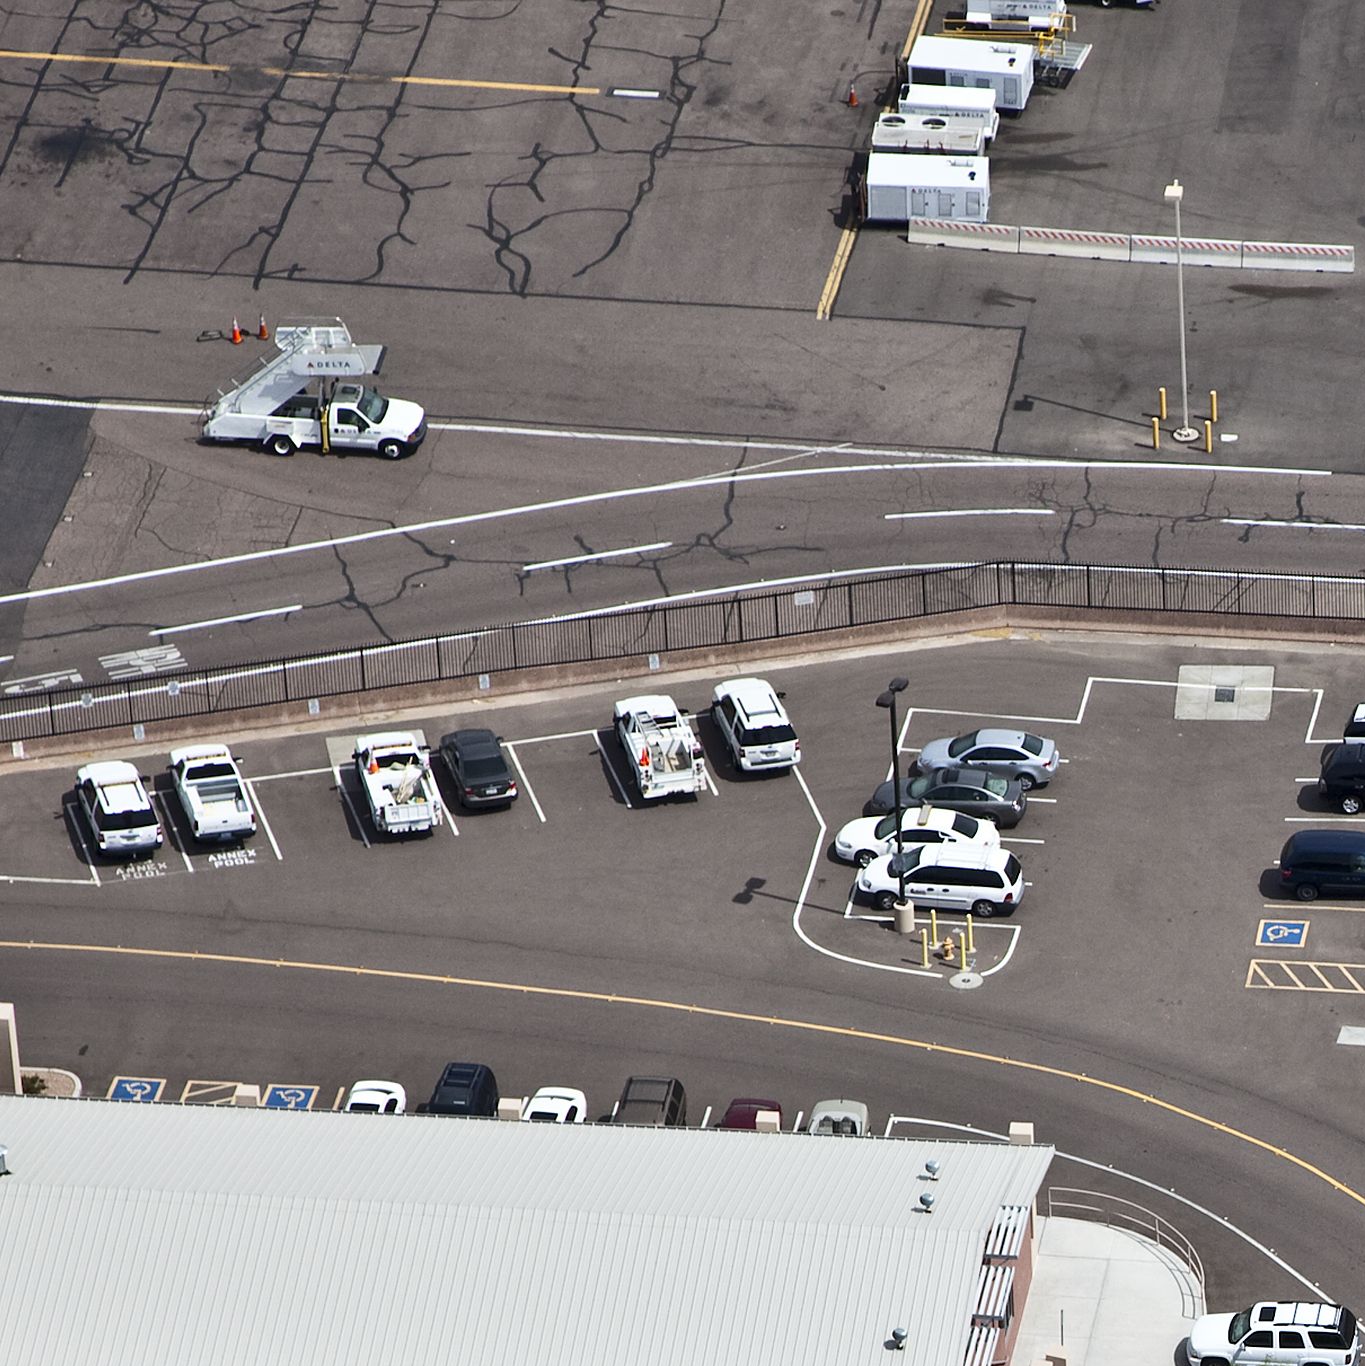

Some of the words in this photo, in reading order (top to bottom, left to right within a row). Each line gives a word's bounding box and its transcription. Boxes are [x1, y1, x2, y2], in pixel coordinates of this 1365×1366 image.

[208, 849, 257, 863] ANNEX
[214, 857, 256, 869] POOL
[116, 860, 168, 876] ANNEX
